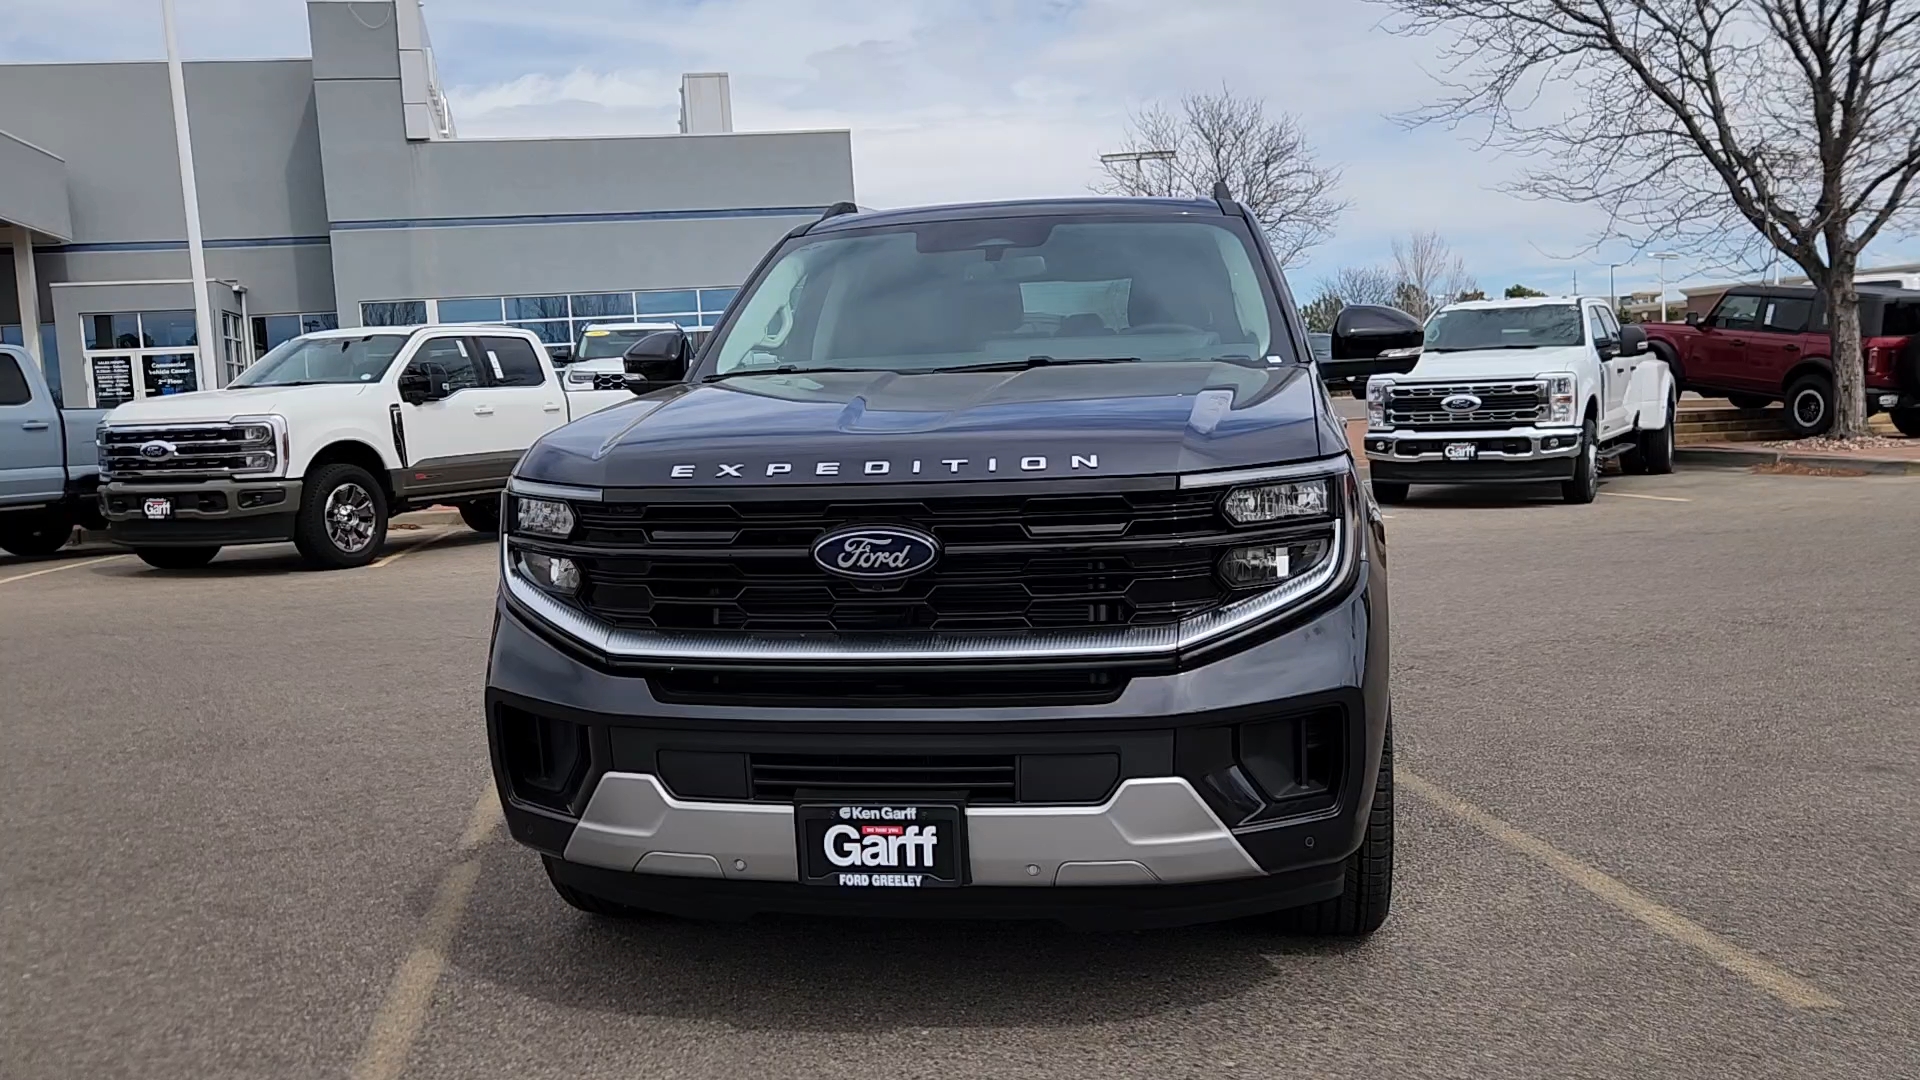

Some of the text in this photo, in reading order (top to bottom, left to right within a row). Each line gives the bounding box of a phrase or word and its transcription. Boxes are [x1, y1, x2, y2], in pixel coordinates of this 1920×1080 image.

[1444, 445, 1475, 457] Garff
[670, 454, 1099, 479] EXPEDITION
[144, 501, 170, 515] Garff
[837, 537, 912, 568] Ford
[851, 806, 917, 820] Ken Garff
[823, 824, 938, 867] Garff
[839, 873, 922, 887] FORD GREELEY
